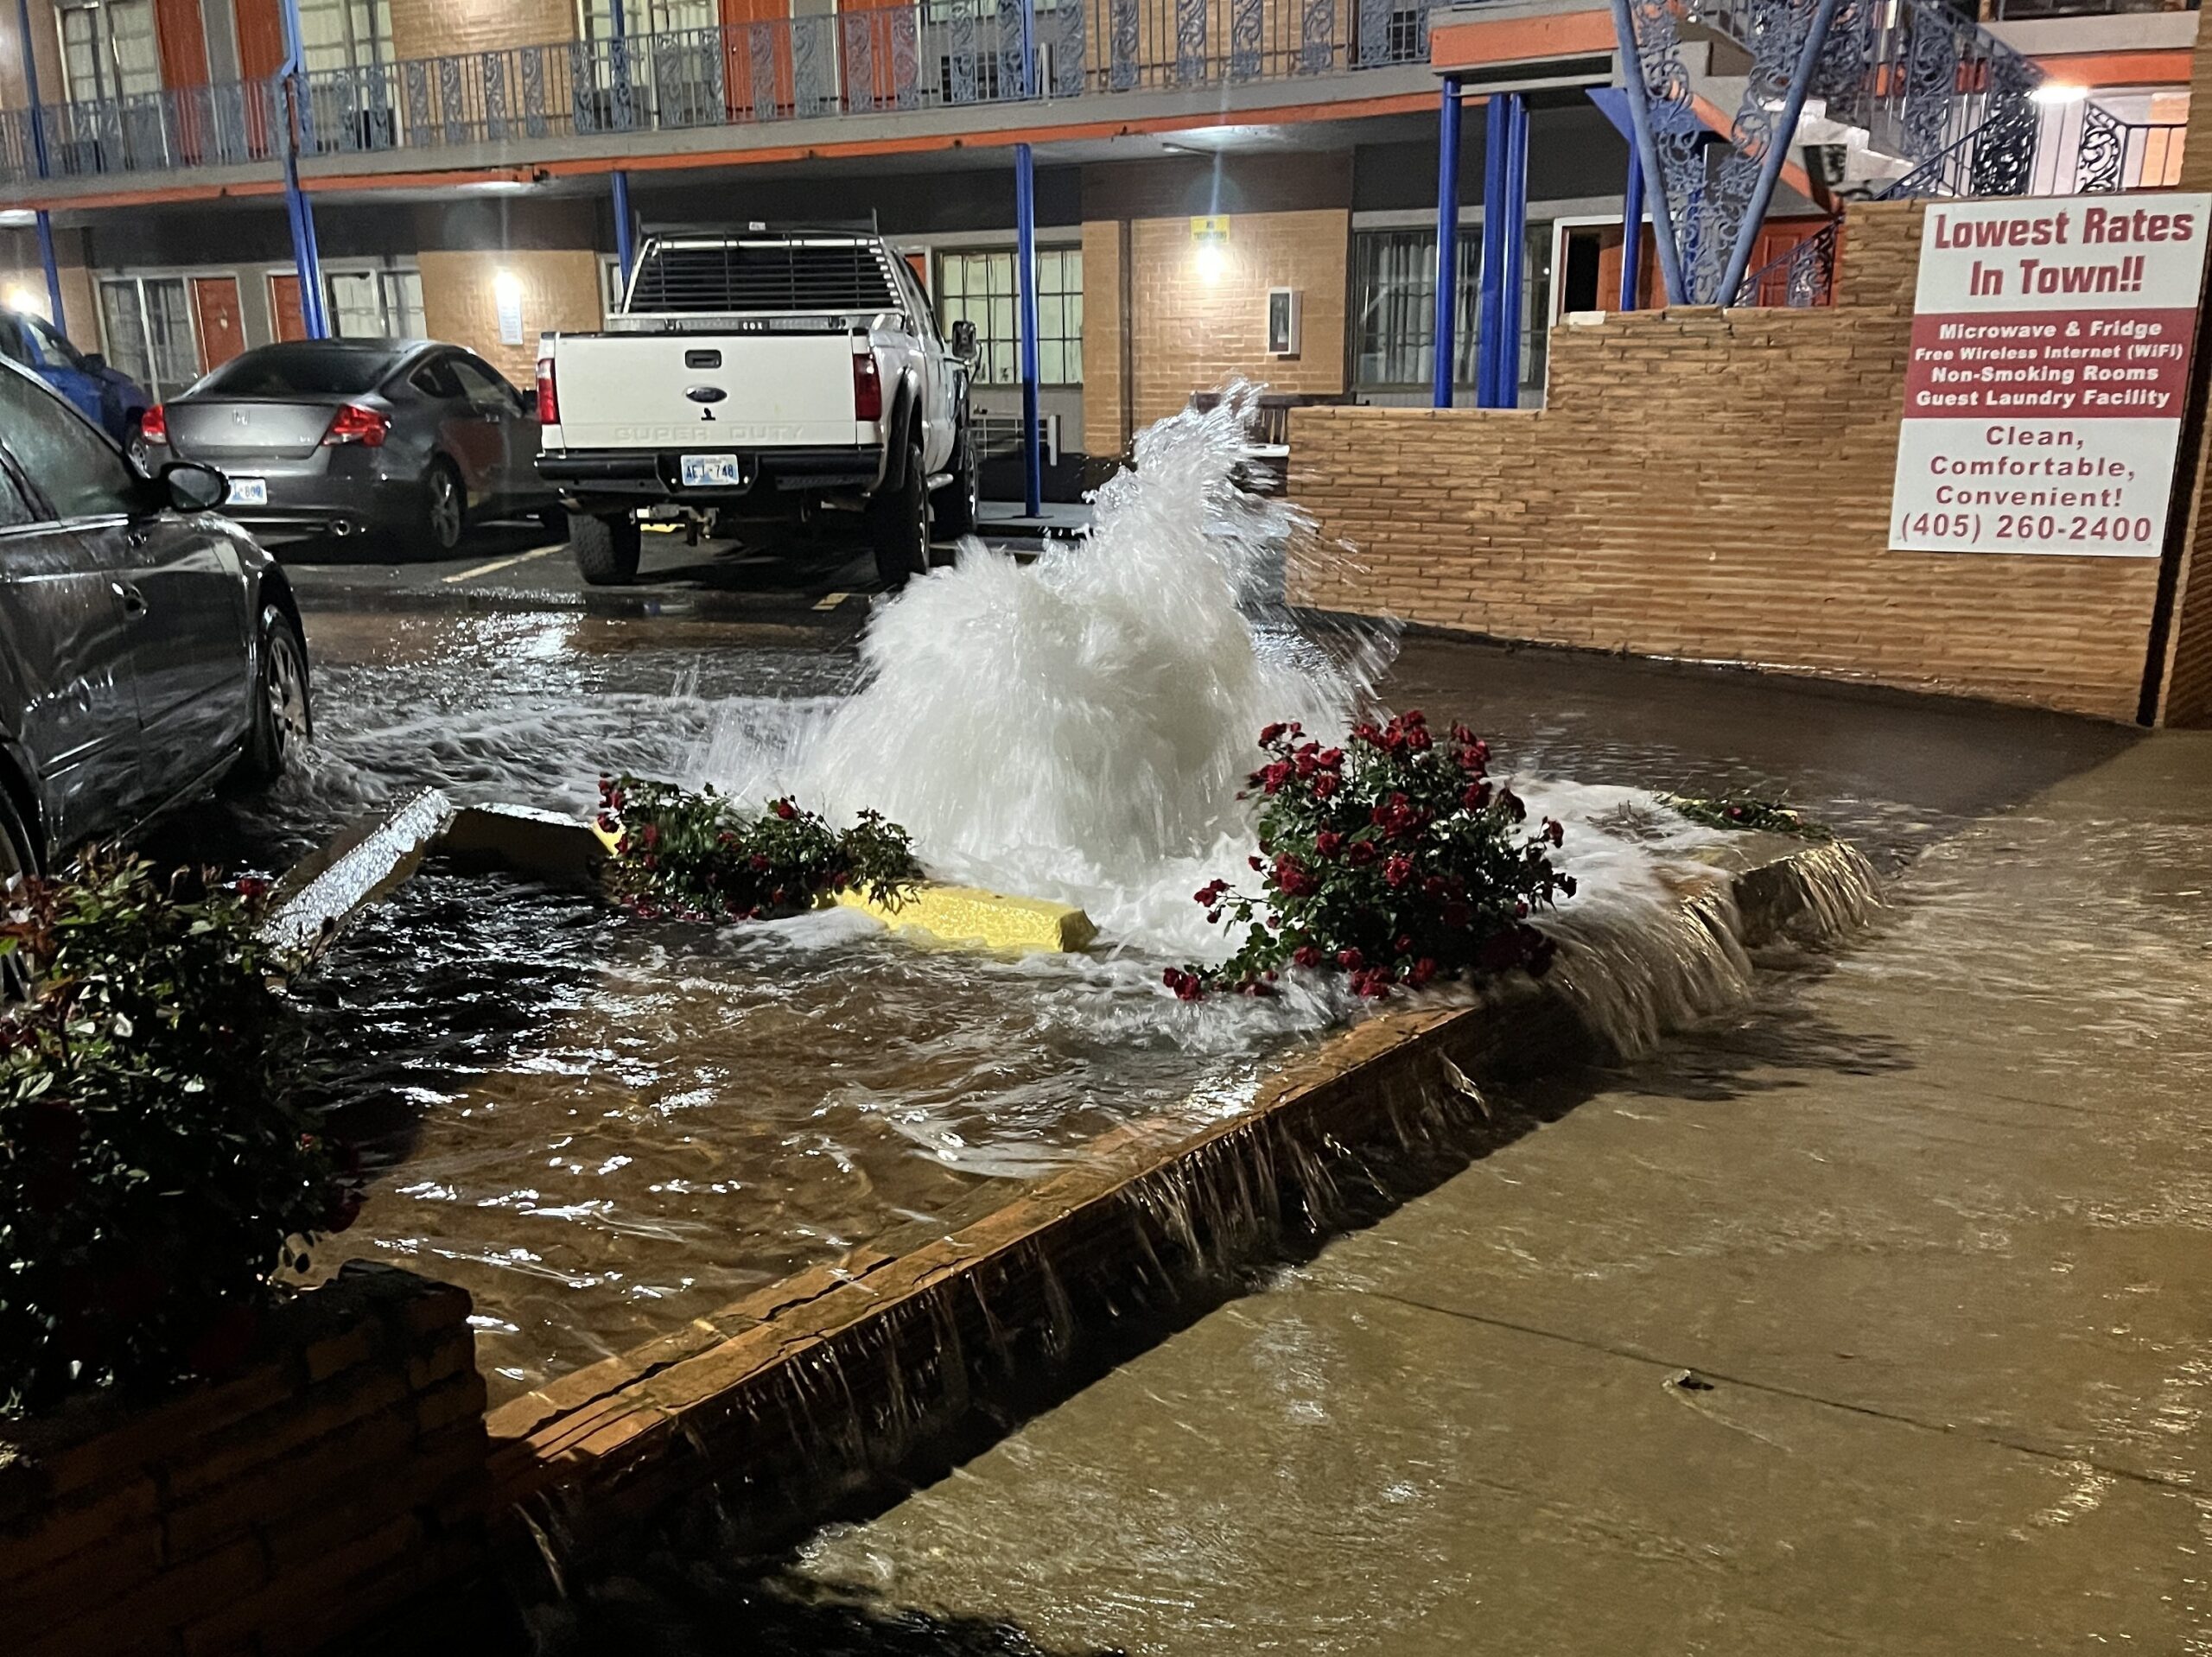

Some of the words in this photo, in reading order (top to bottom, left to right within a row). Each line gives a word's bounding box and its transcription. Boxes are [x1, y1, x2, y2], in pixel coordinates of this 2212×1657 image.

[1935, 207, 2069, 249] Lowest
[2083, 207, 2195, 244] Rates
[1970, 261, 2004, 295] In
[2020, 256, 2145, 294] Town!!
[1940, 324, 2056, 340] Microwave
[2065, 321, 2080, 336] &
[2090, 321, 2162, 340] Fridge
[1916, 348, 1954, 360] Free
[1960, 346, 2037, 360] Wireless
[2044, 346, 2120, 359] Internet
[1932, 366, 2074, 384] Non-Smoking
[2083, 365, 2158, 380] Rooms
[1916, 390, 1978, 406] Guest
[1986, 390, 2075, 409] Laundry
[2083, 390, 2170, 408] Facility
[1986, 426, 2084, 449] Clean,
[1930, 456, 2135, 480] Comfortable,
[1936, 486, 2122, 507] Convenient!
[1902, 513, 1980, 543] (405)
[1996, 515, 2152, 541] 260-2400
